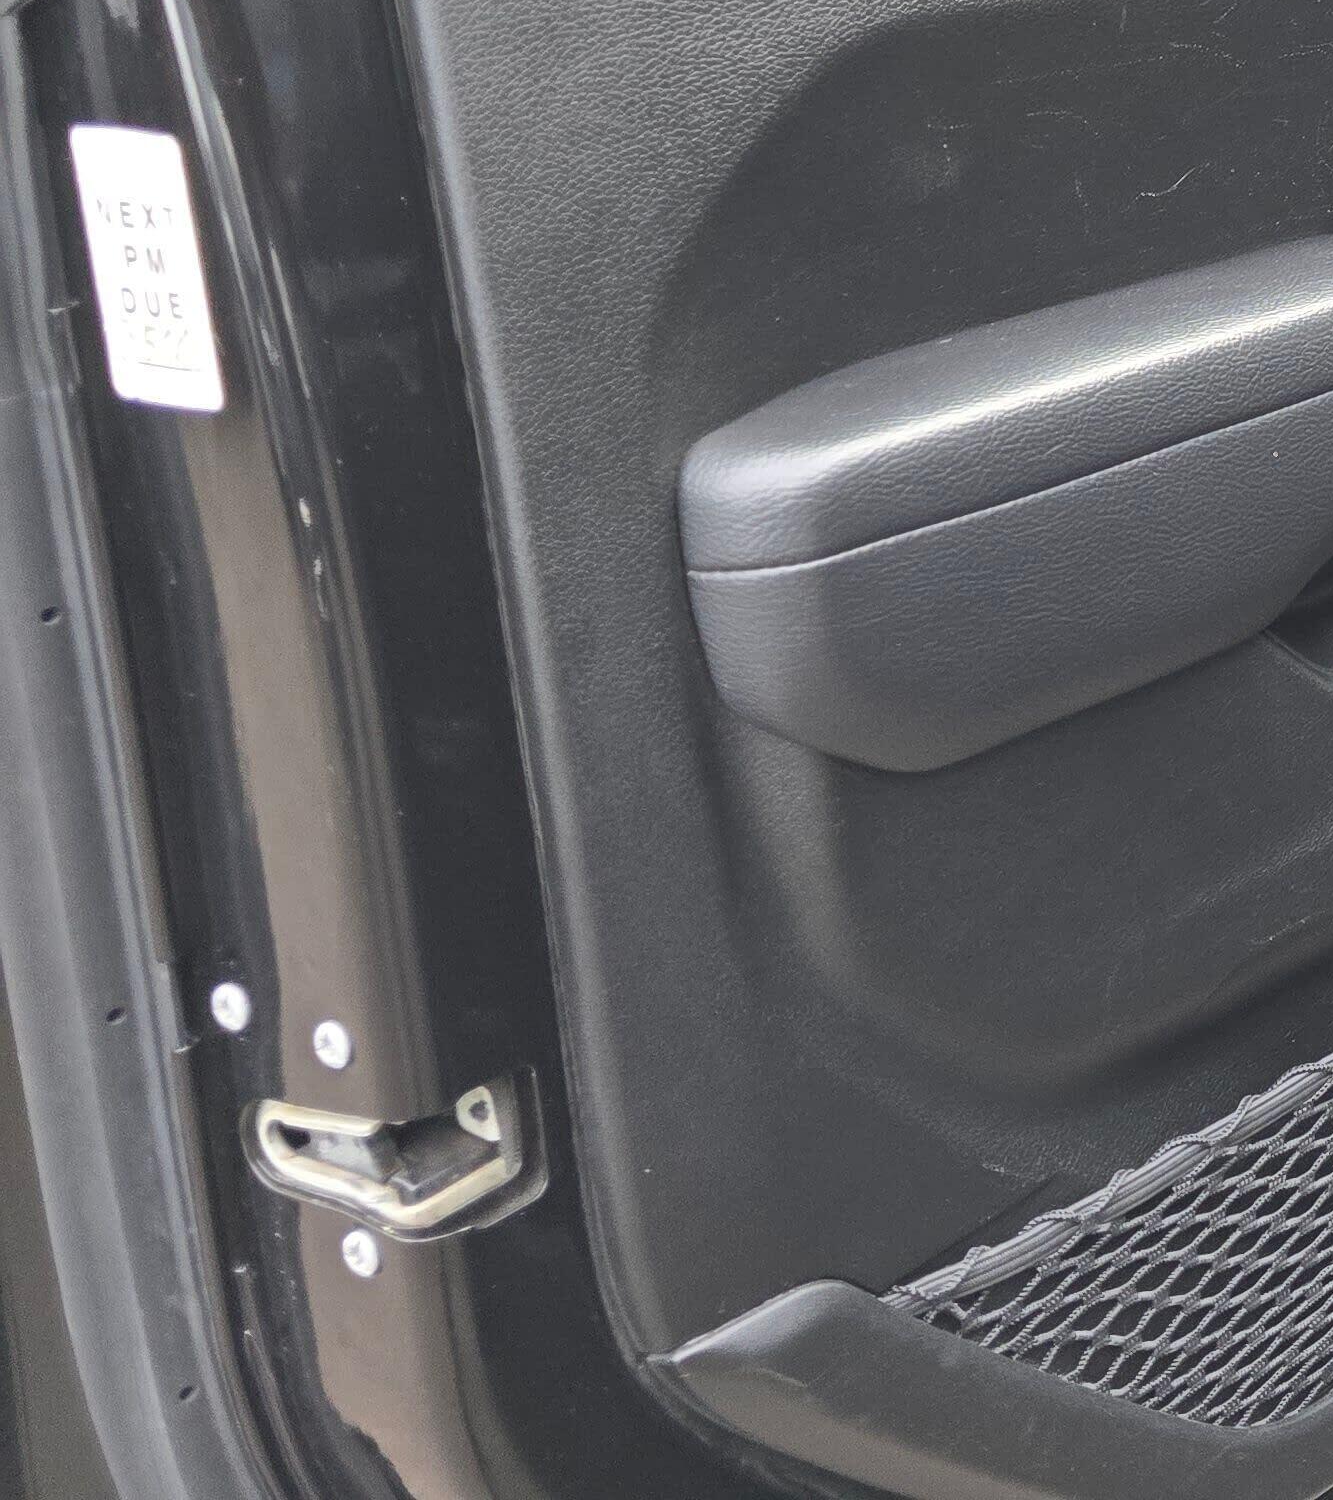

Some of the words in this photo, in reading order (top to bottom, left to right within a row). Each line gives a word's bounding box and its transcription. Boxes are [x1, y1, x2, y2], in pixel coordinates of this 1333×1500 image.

[96, 198, 174, 230] NEXT
[124, 244, 166, 274] PM
[120, 287, 184, 320] DUE
